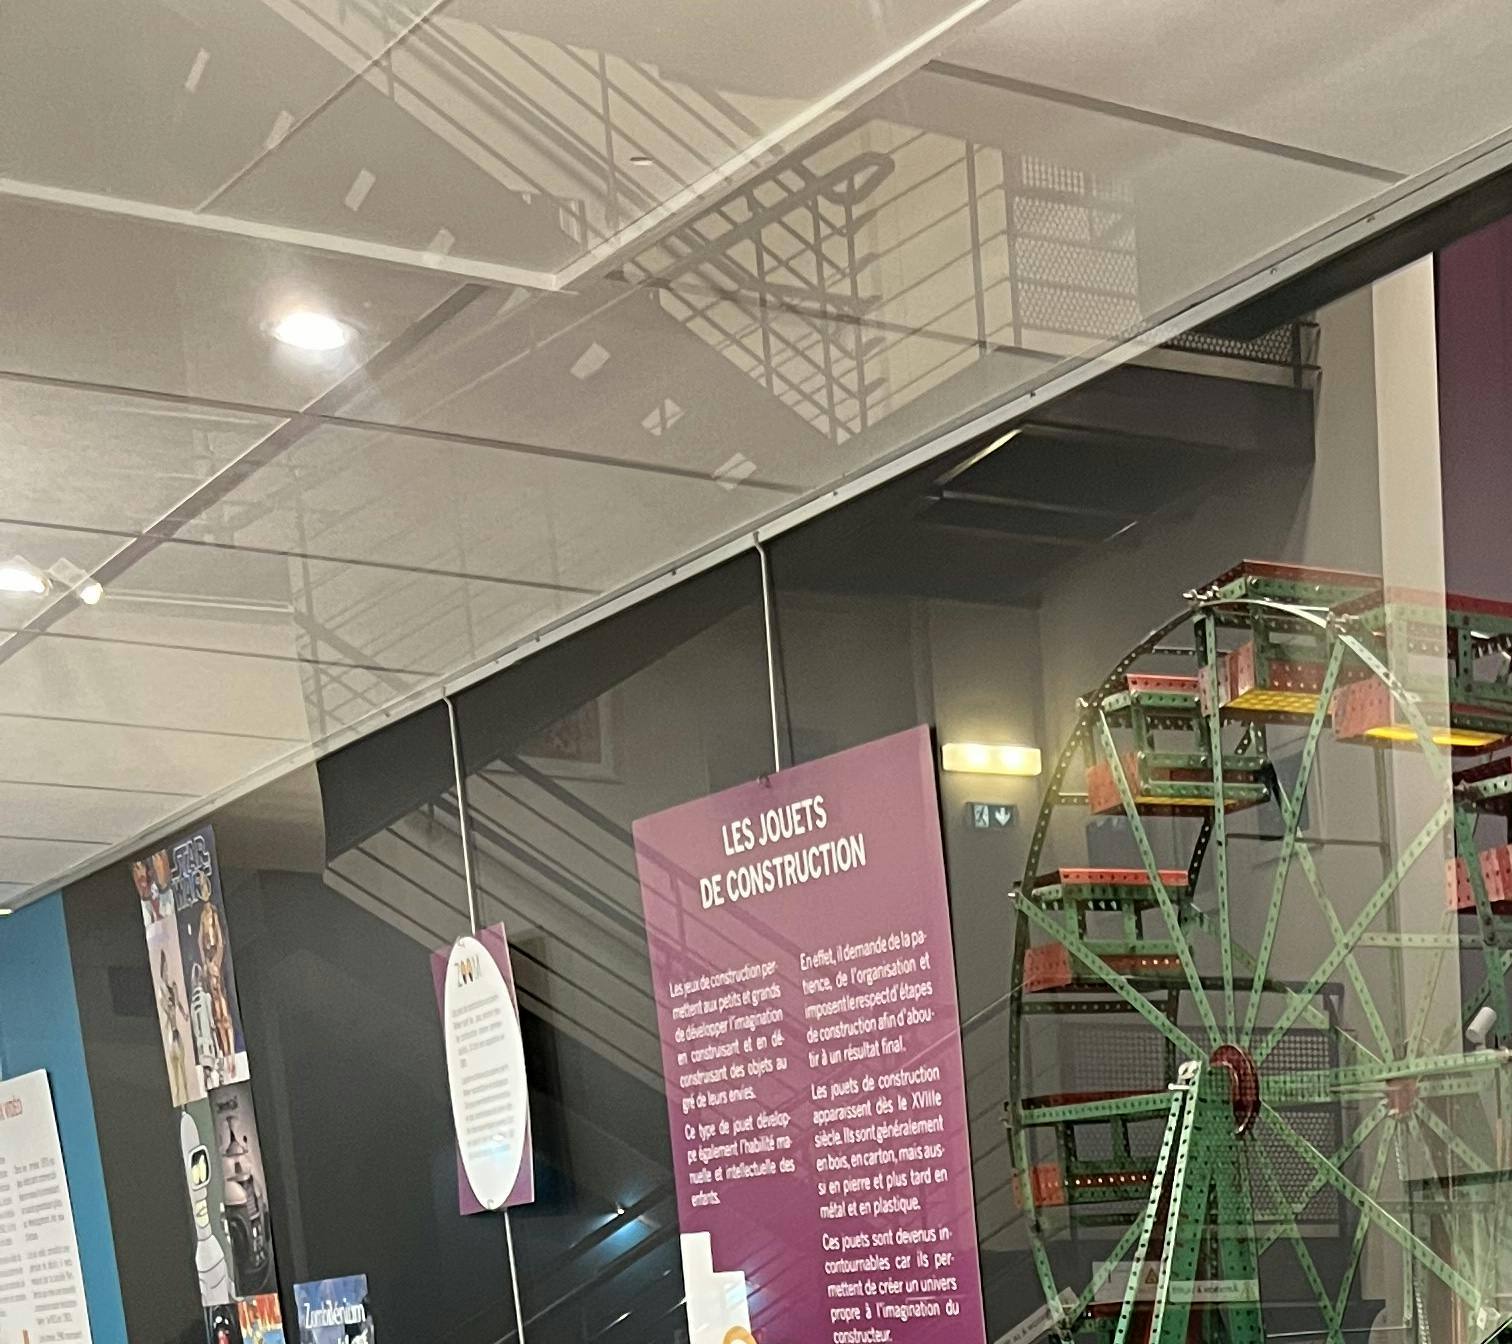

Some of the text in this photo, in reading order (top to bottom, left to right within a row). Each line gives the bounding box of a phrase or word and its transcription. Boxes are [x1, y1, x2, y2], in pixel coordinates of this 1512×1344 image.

[722, 796, 827, 855] LES JOUETS
[700, 834, 866, 908] DE CONSTRUCTION
[807, 1008, 935, 1043] de construction afin d'abou-
[809, 1035, 906, 1067] tir à un résultat final.
[811, 1067, 940, 1099] Les jouets de construction
[813, 1100, 872, 1125] apparaissent
[876, 1096, 893, 1114] dès
[898, 1095, 907, 1110] le
[817, 1144, 945, 1171] en bois, en carton, mais aus-
[818, 1168, 948, 1195] si en pierre et plus tard en
[820, 1196, 921, 1218] métal et en plastique.
[823, 1228, 952, 1251] Ces jouets sont devenus in-
[825, 1251, 954, 1274] contournables car ils per-
[828, 1277, 957, 1297] mettent de créer un univers
[831, 1300, 959, 1323] propre à l'imagination du
[833, 1328, 893, 1344] constructeur.
